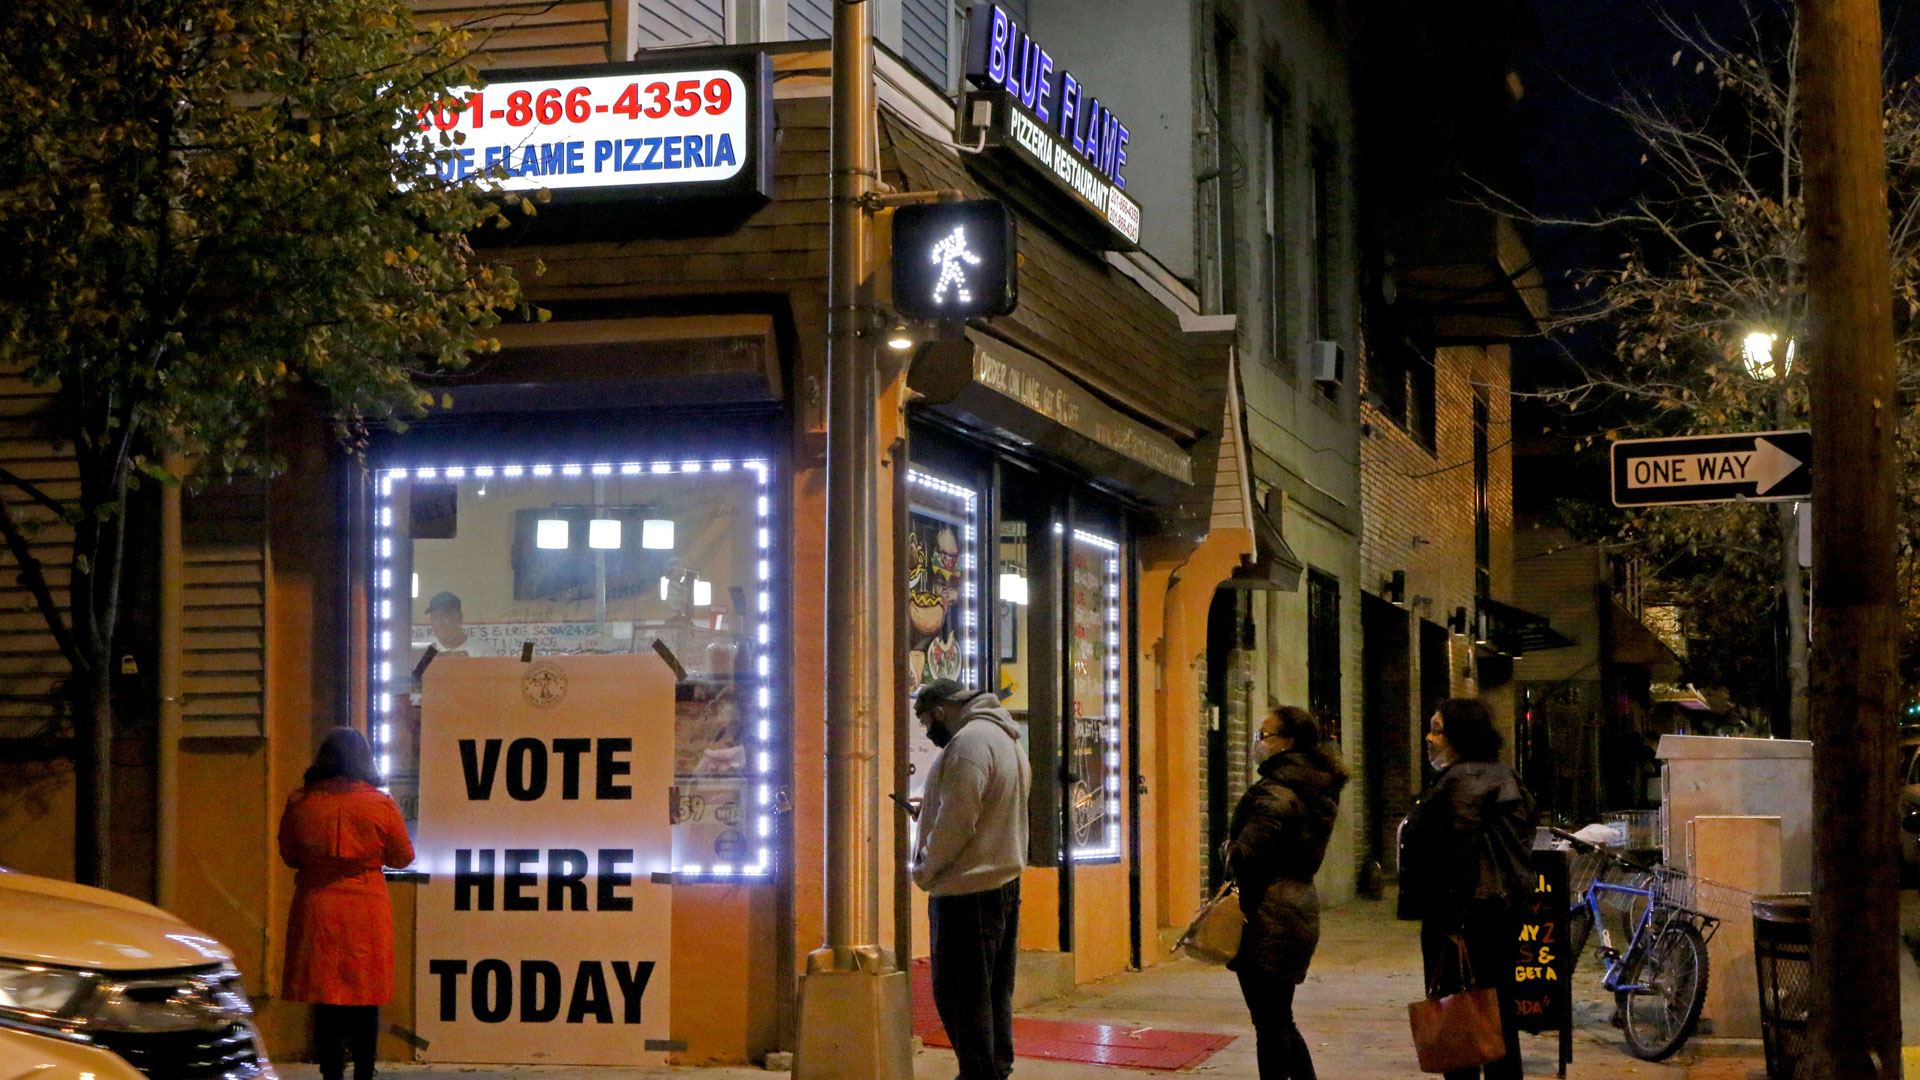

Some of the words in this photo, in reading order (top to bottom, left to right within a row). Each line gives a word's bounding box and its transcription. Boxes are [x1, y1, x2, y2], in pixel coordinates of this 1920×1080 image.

[989, 5, 1053, 123] BLUE
[1060, 72, 1130, 190] FLAME
[484, 141, 584, 180] FLAME
[594, 133, 737, 173] PIZZERIA
[1010, 107, 1053, 169] PIZZERIA
[1054, 147, 1109, 213] RESTAURANT
[1634, 458, 1687, 485] ONE
[1697, 454, 1752, 481] WAY
[458, 737, 633, 801] VOTE
[454, 848, 634, 912] HERE
[429, 958, 656, 1024] TODAY
[1515, 965, 1542, 983] GET
[1545, 966, 1558, 981] A
